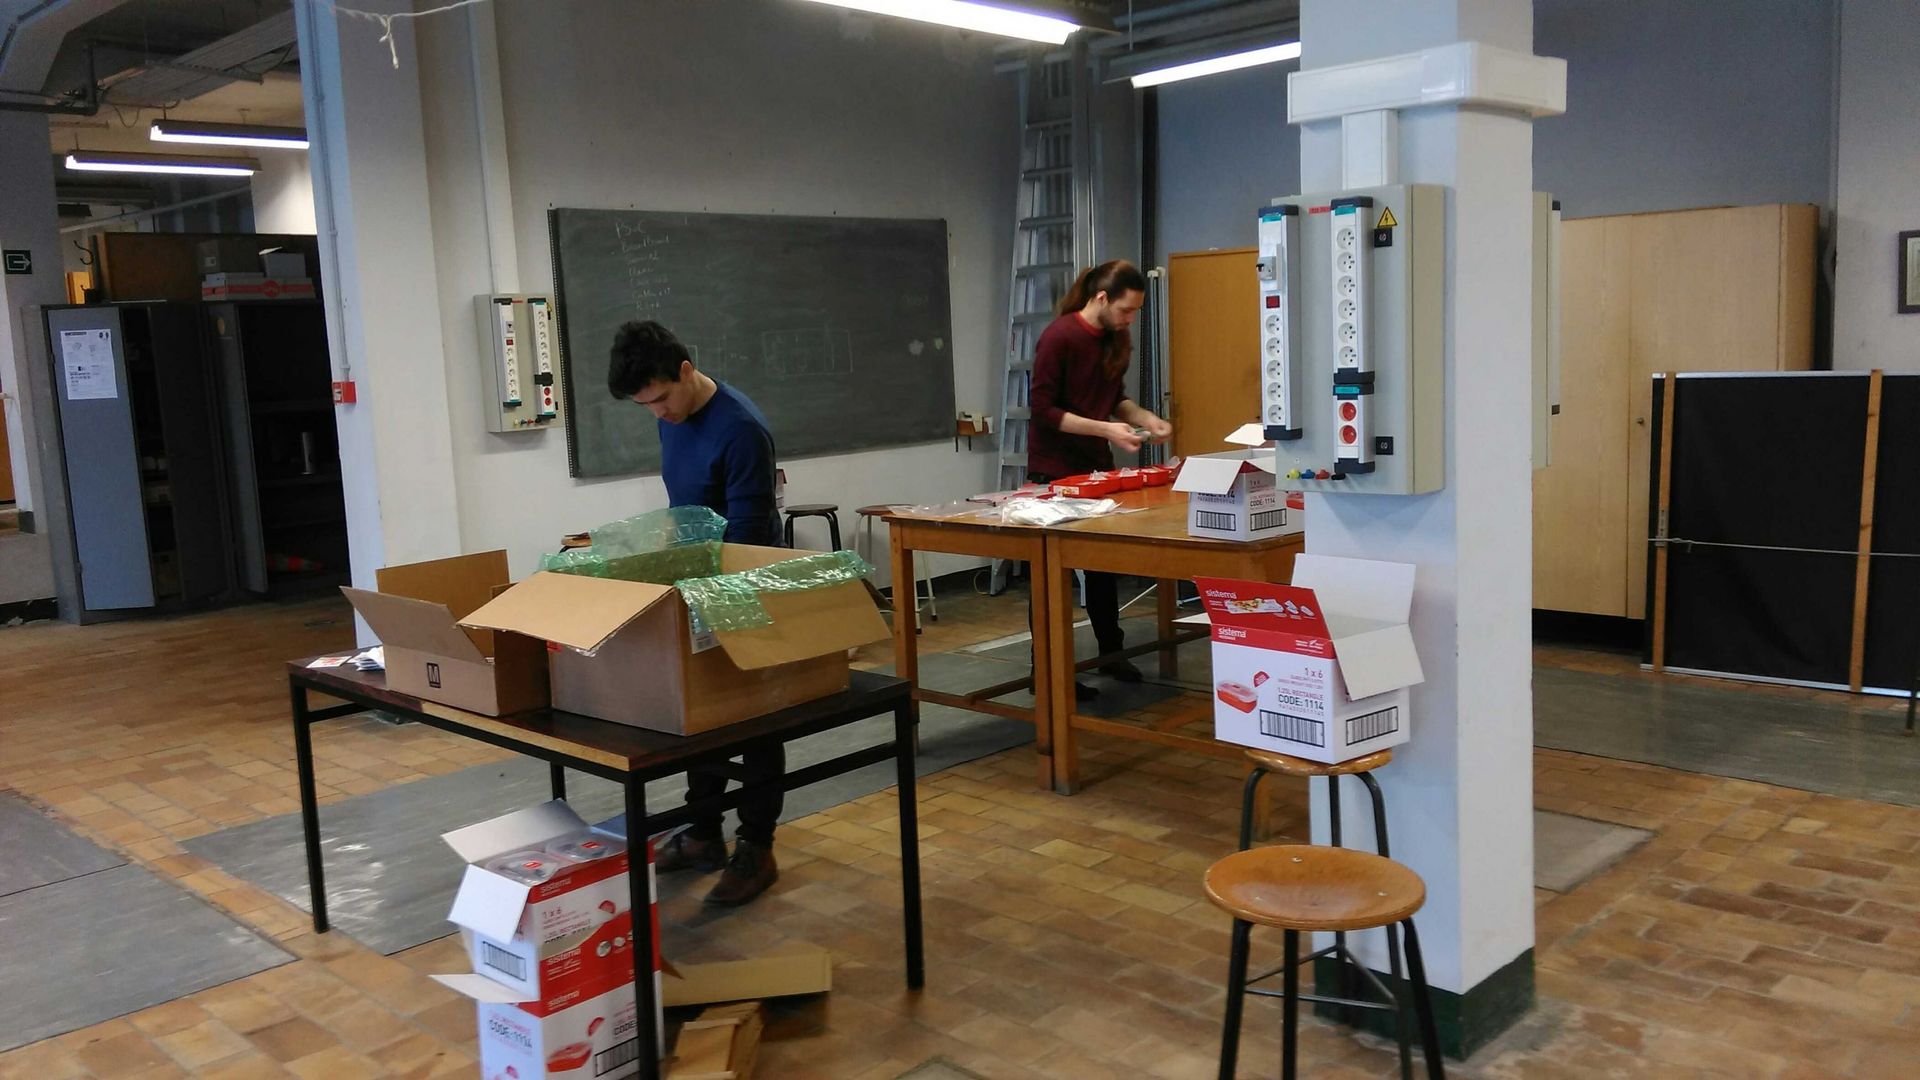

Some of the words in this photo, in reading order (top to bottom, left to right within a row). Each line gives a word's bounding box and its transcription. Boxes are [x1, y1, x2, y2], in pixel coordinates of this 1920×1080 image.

[1205, 589, 1237, 600] sistema
[1218, 627, 1247, 639] sistema
[1305, 667, 1309, 676] 1
[1318, 670, 1323, 679] 6
[1292, 689, 1324, 700] RECTANGLE
[1278, 694, 1303, 707] CODE:
[1304, 699, 1324, 710] 1114
[547, 948, 581, 965] sistema
[548, 990, 580, 1007] sistema
